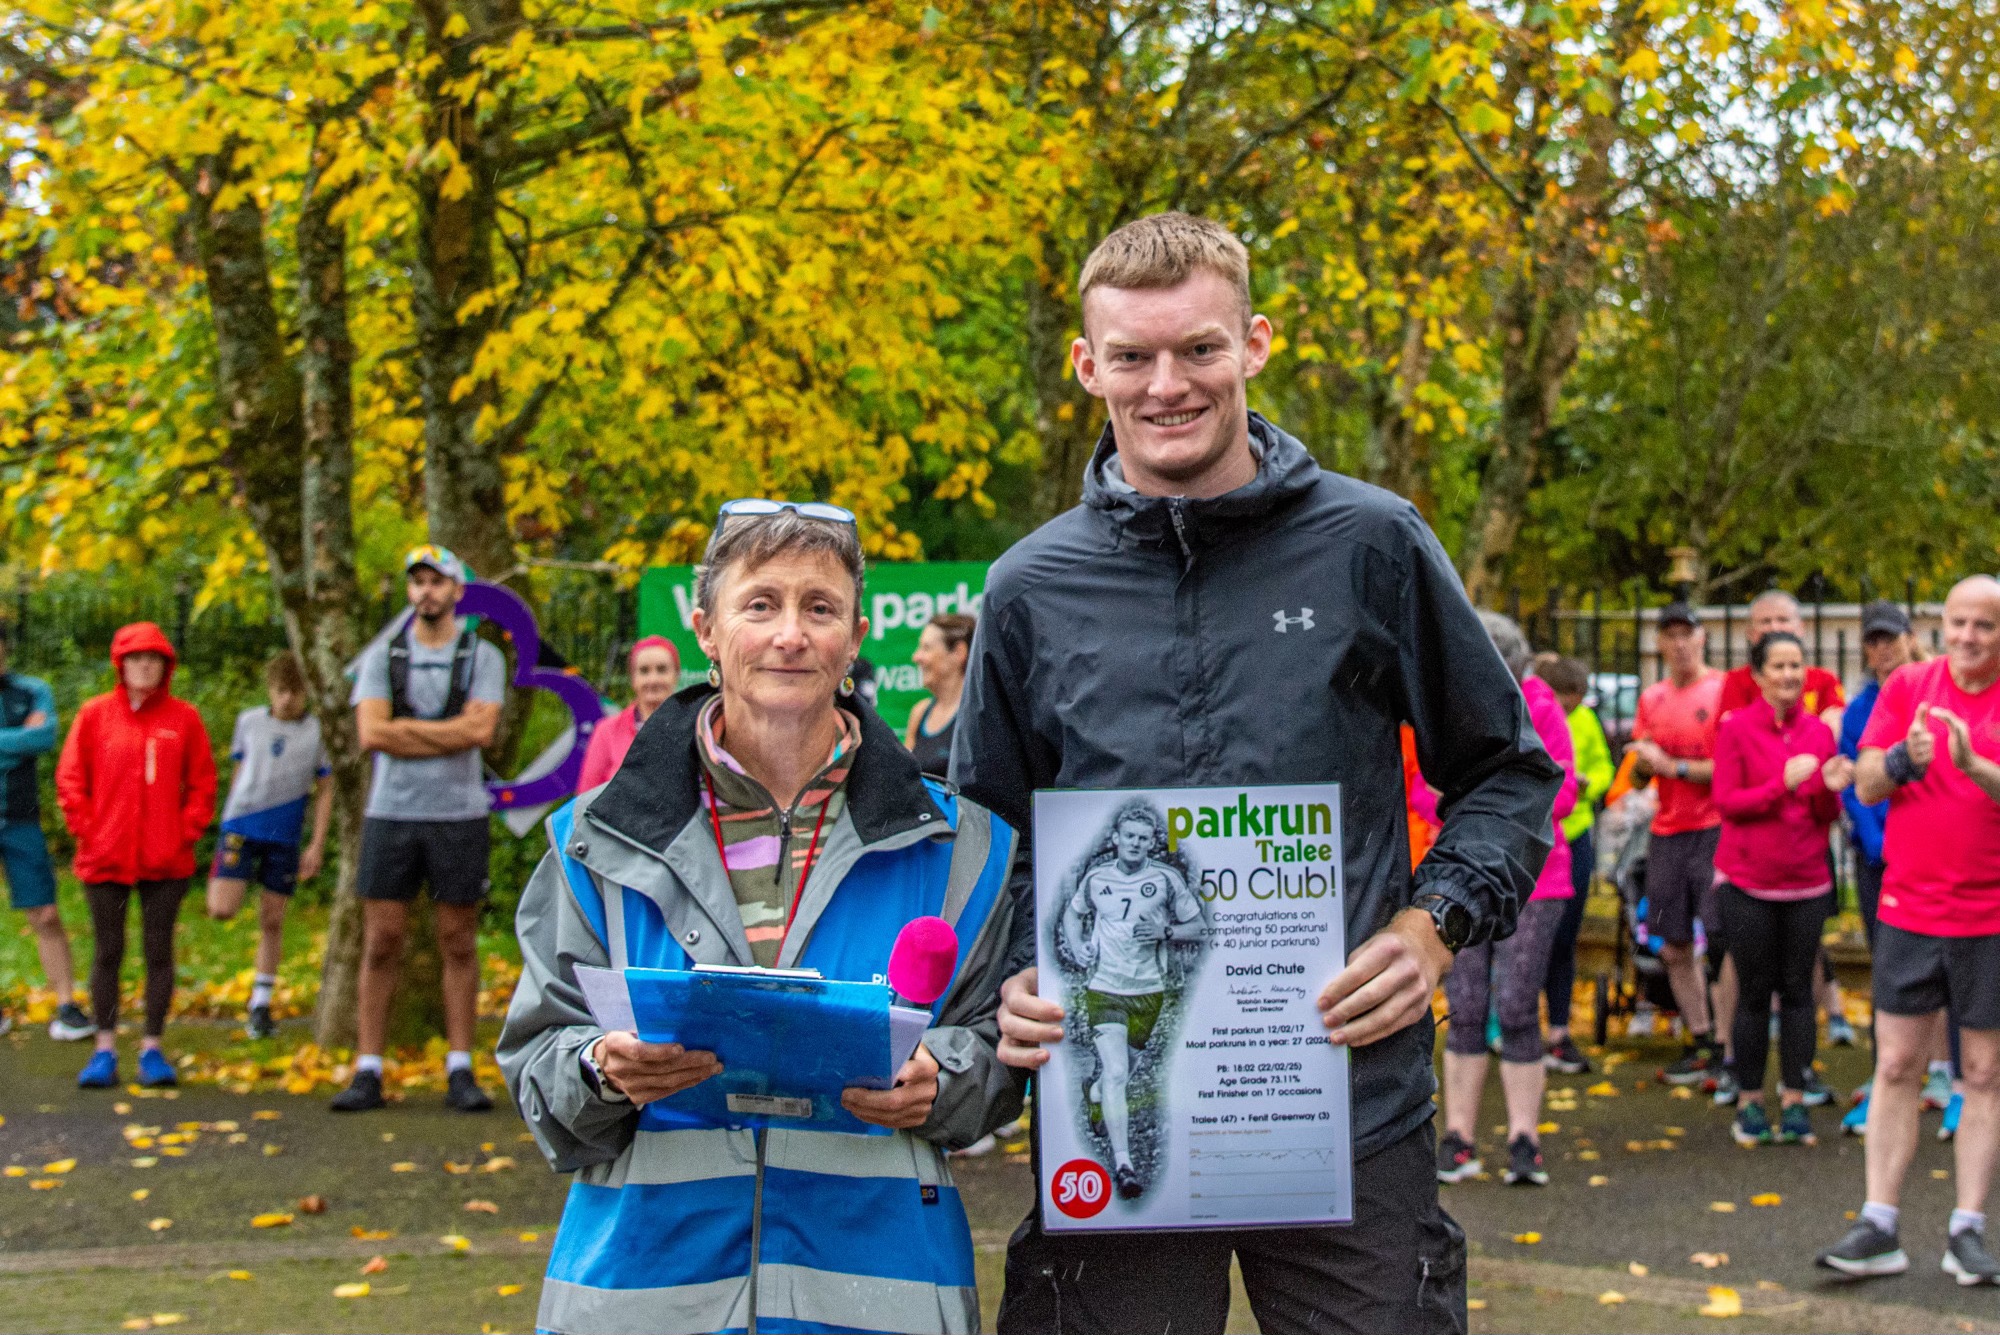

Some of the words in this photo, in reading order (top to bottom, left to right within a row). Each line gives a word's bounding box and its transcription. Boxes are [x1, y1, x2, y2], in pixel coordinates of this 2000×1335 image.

[1167, 793, 1332, 852] parkrun
[1255, 838, 1332, 863] Tralee
[1199, 868, 1238, 902] 50
[1248, 865, 1336, 900] Club!
[1121, 898, 1132, 920] 7
[1212, 911, 1298, 924] Congratulations
[1301, 912, 1316, 921] on
[1200, 925, 1262, 937] completing
[1265, 924, 1278, 934] 50
[1281, 922, 1329, 935] parkruns!
[1224, 938, 1236, 949] 40
[1239, 938, 1268, 950] junior
[1271, 936, 1321, 949] parkruns)
[1226, 963, 1263, 977] David
[1266, 962, 1306, 976] Chute
[1260, 1005, 1284, 1013] Director
[1212, 1027, 1229, 1036] First
[1231, 1026, 1265, 1037] parkrun
[1267, 1024, 1305, 1035] 12/02/17
[1186, 1041, 1207, 1049] Most
[1209, 1039, 1247, 1050] parkruns
[1249, 1039, 1257, 1047] in
[1268, 1039, 1290, 1048] year:
[1292, 1037, 1303, 1045] 27
[1217, 1065, 1230, 1073] PB:
[1257, 1063, 1303, 1073] (22/02/25)
[1219, 1077, 1237, 1087] Age
[1240, 1076, 1268, 1085] Grade
[1270, 1075, 1301, 1084] 73.11%
[1198, 1090, 1215, 1099] First
[1217, 1089, 1249, 1098] Finisher
[1266, 1088, 1276, 1097] 17
[1278, 1086, 1323, 1096] occasions
[1191, 1115, 1218, 1124] Tralee
[1221, 1114, 1238, 1124] (47)
[1248, 1113, 1269, 1122] Fenit
[1271, 1113, 1316, 1122] Greenway
[1318, 1111, 1330, 1120] (3)
[1058, 1170, 1104, 1205] 50
